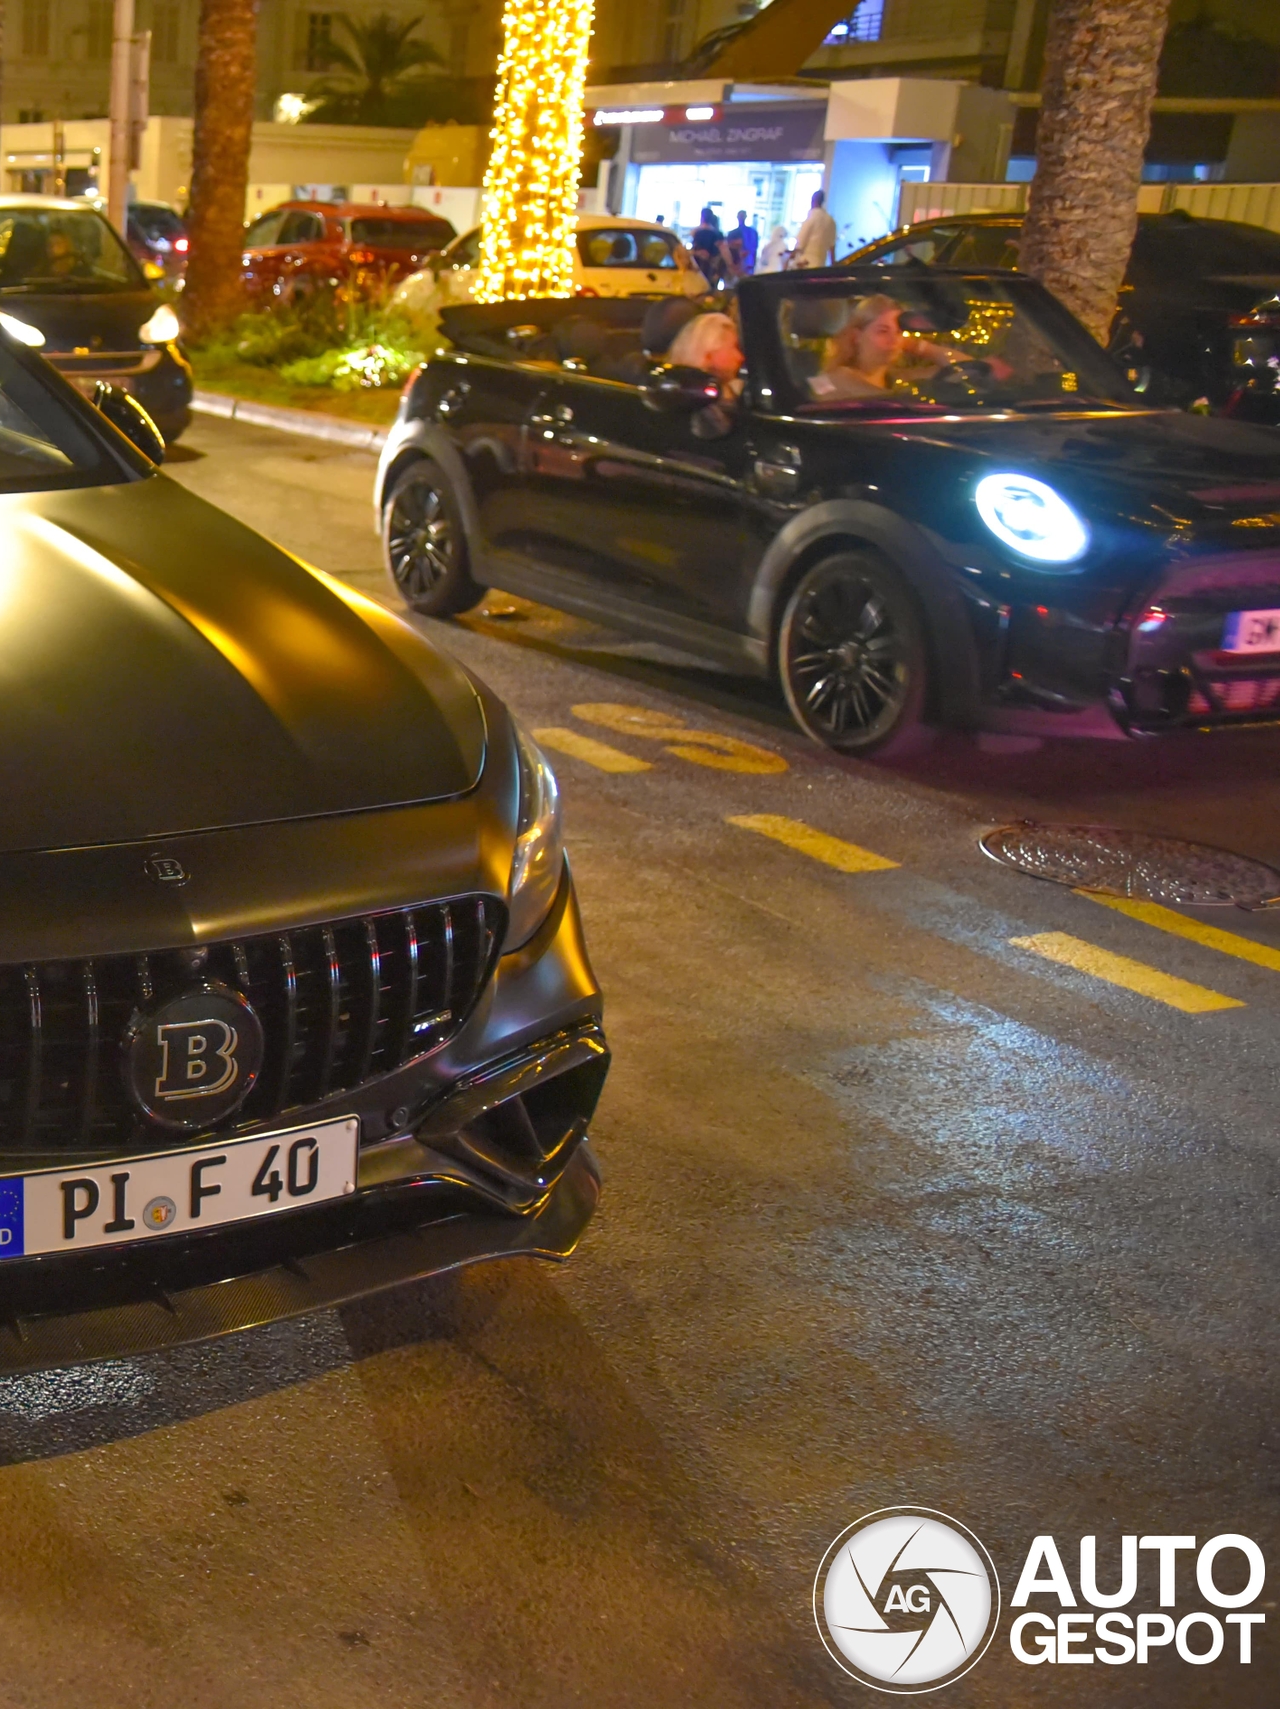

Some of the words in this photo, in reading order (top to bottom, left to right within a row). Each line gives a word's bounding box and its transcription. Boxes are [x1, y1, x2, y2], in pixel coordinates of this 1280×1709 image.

[151, 858, 185, 881] B
[154, 1018, 239, 1101] B
[60, 1171, 135, 1240] PI
[189, 1155, 227, 1219] F
[251, 1137, 319, 1202] 40
